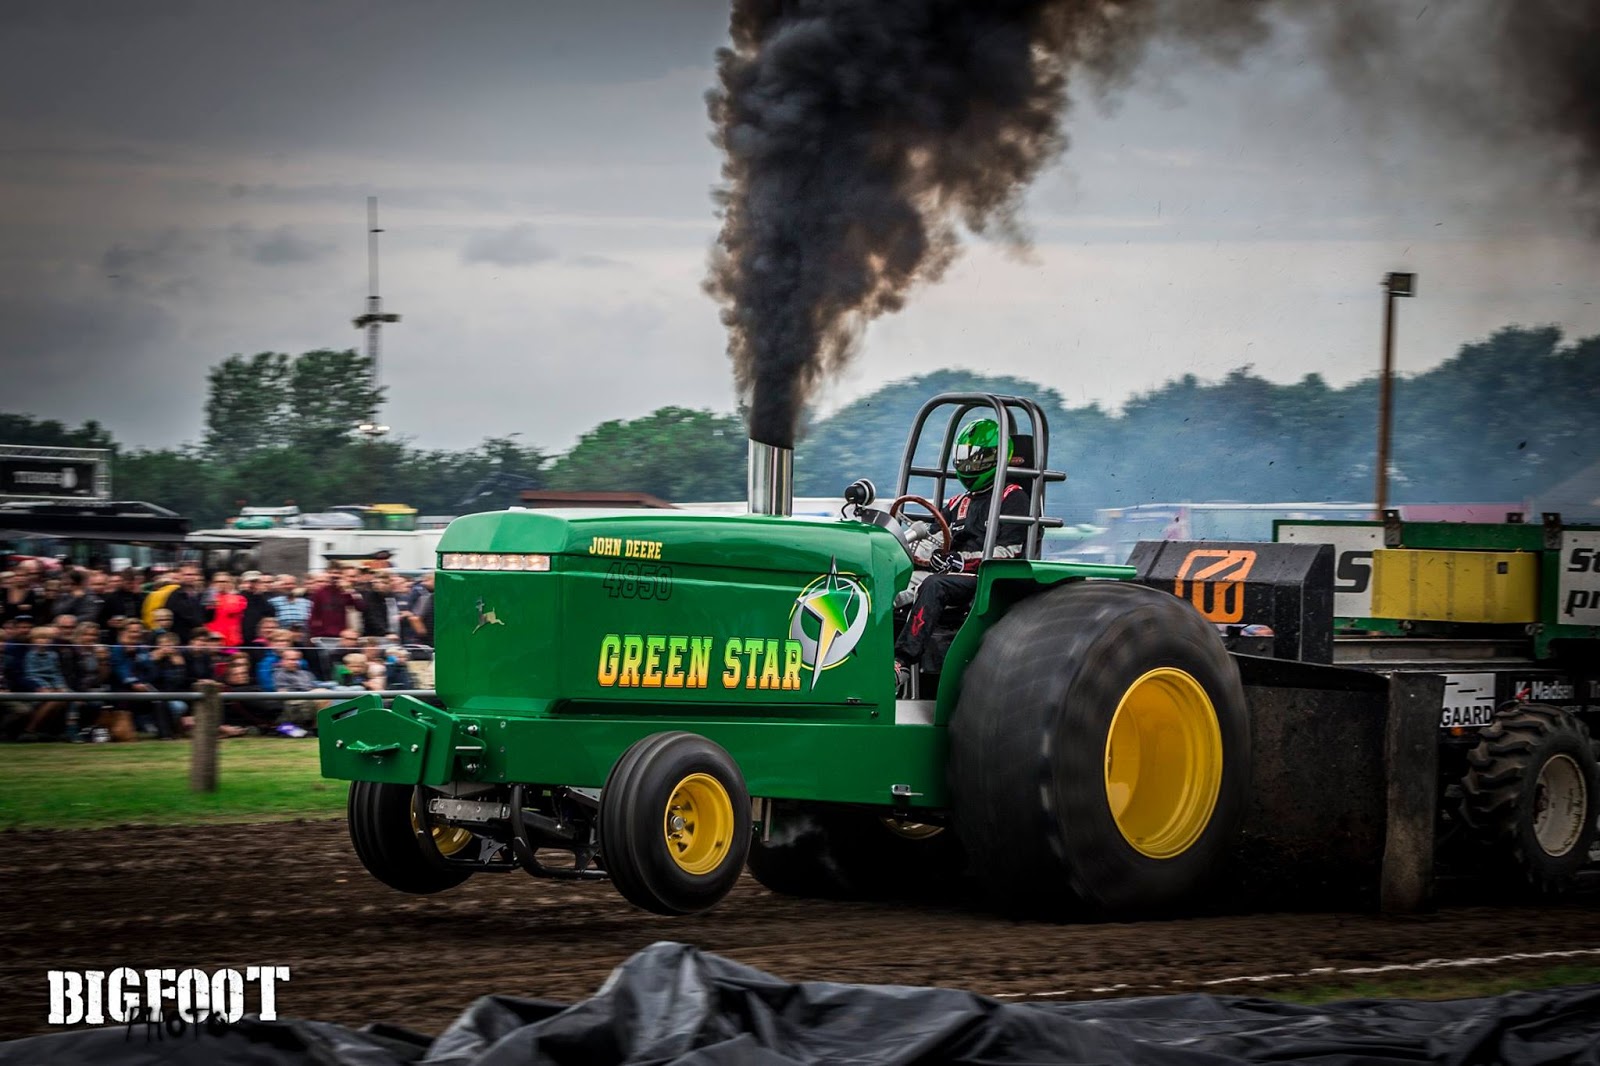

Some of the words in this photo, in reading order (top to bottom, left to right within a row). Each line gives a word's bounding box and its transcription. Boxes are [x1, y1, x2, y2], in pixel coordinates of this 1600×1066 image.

[588, 536, 622, 557] JOHN
[625, 538, 663, 560] DEERE
[602, 562, 673, 601] 4850
[597, 633, 713, 689] GREEN
[722, 637, 803, 691] STAR
[1441, 706, 1492, 725] GAARD
